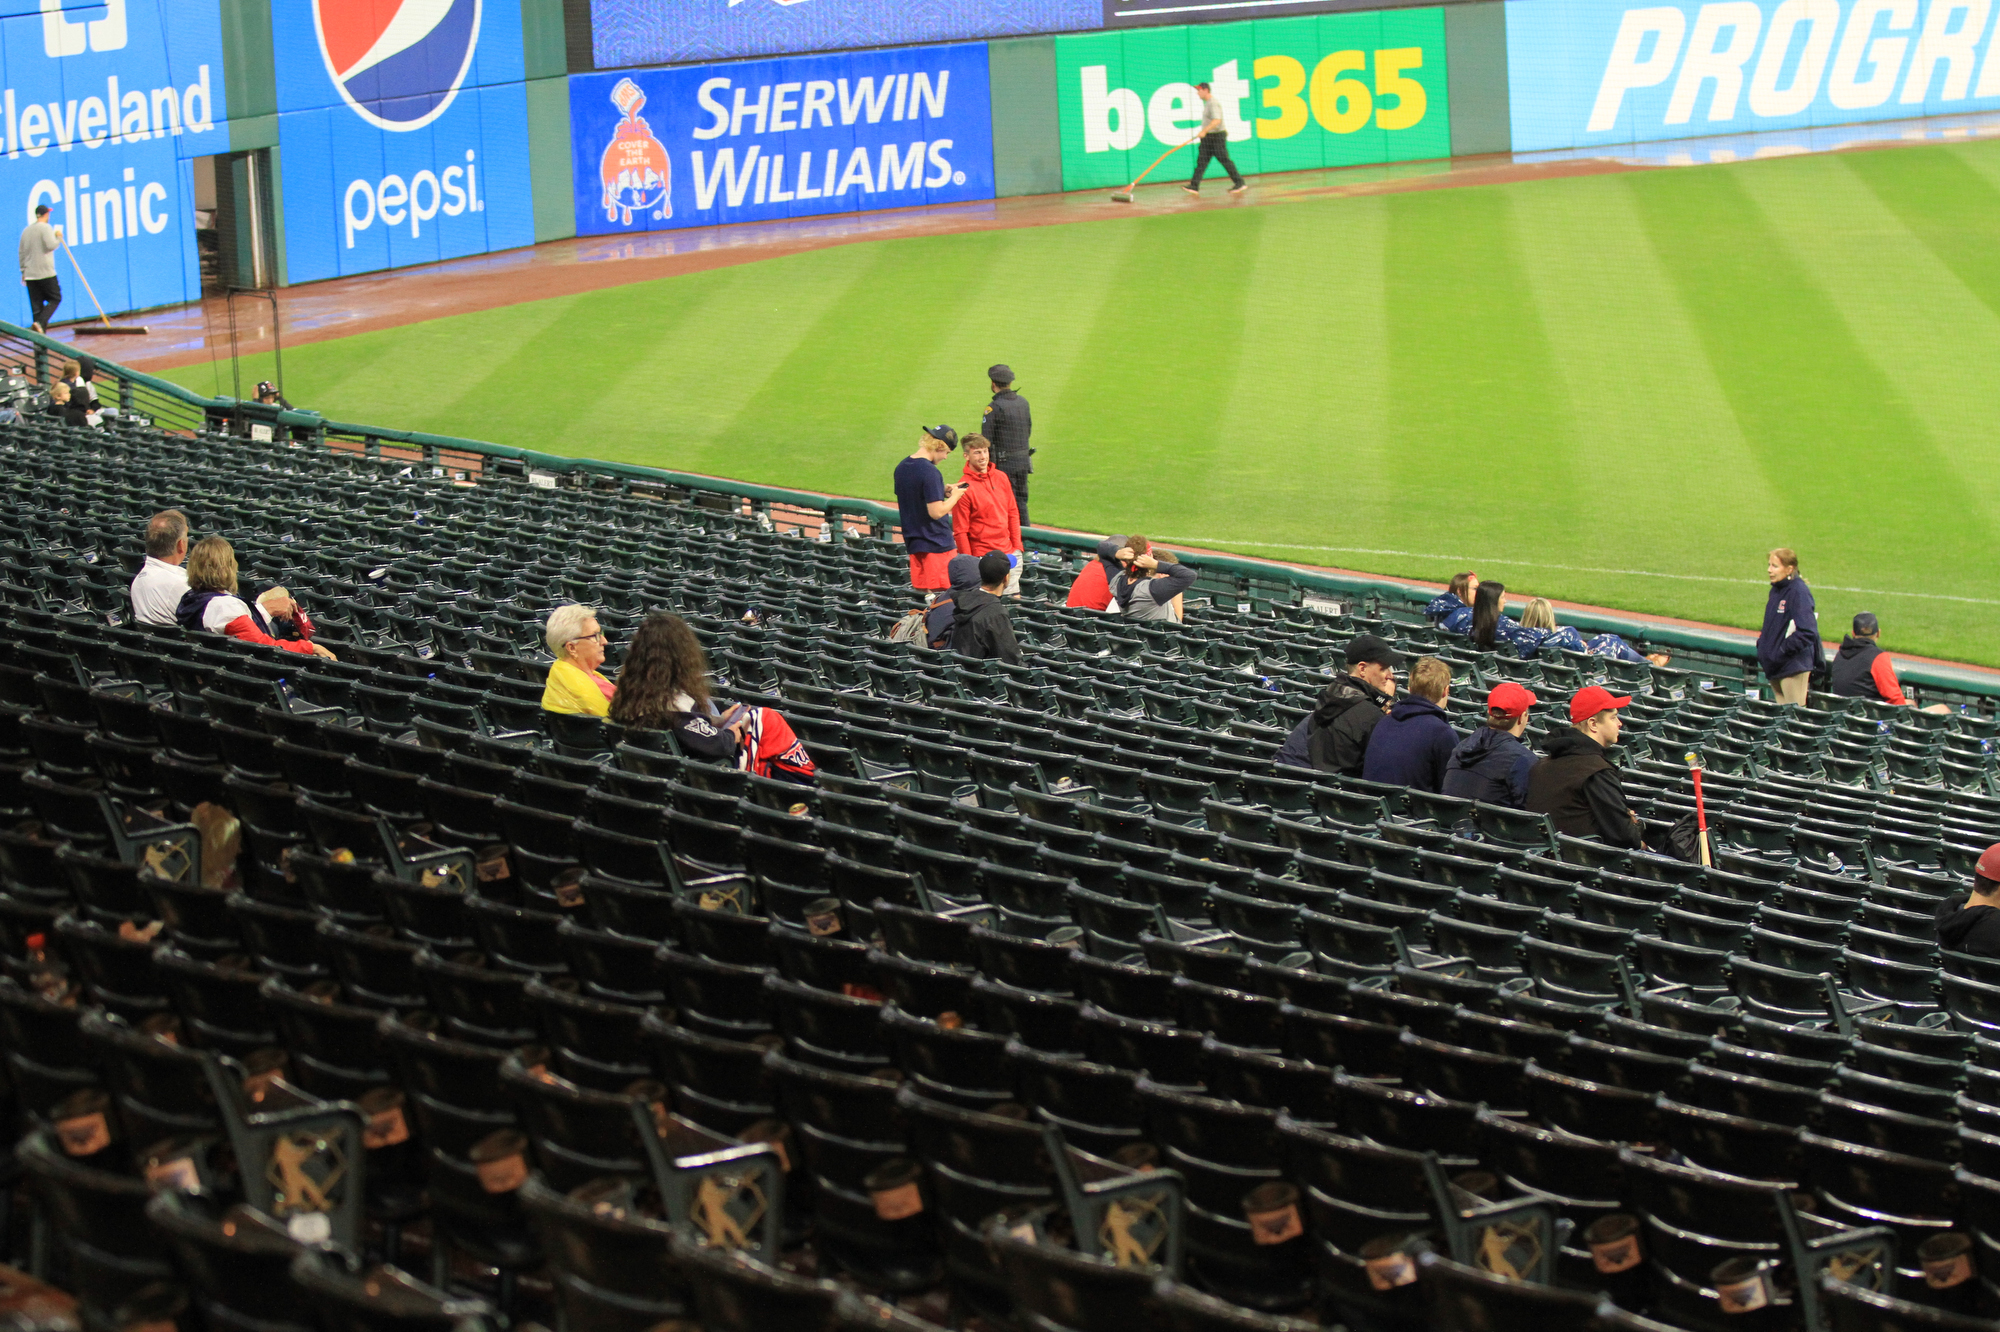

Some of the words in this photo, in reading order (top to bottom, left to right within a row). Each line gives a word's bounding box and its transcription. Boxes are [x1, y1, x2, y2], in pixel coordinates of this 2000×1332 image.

[1080, 46, 1427, 154] bet365
[1586, 0, 2000, 132] PROGR
[0, 64, 214, 160] leveland
[692, 70, 949, 140] SHERWIN
[618, 140, 649, 150] COVER
[620, 157, 650, 166] EARTH
[625, 149, 643, 157] THE
[691, 139, 953, 210] WILLIAMS
[27, 167, 168, 247] Clinic
[344, 149, 477, 249] pepsi
